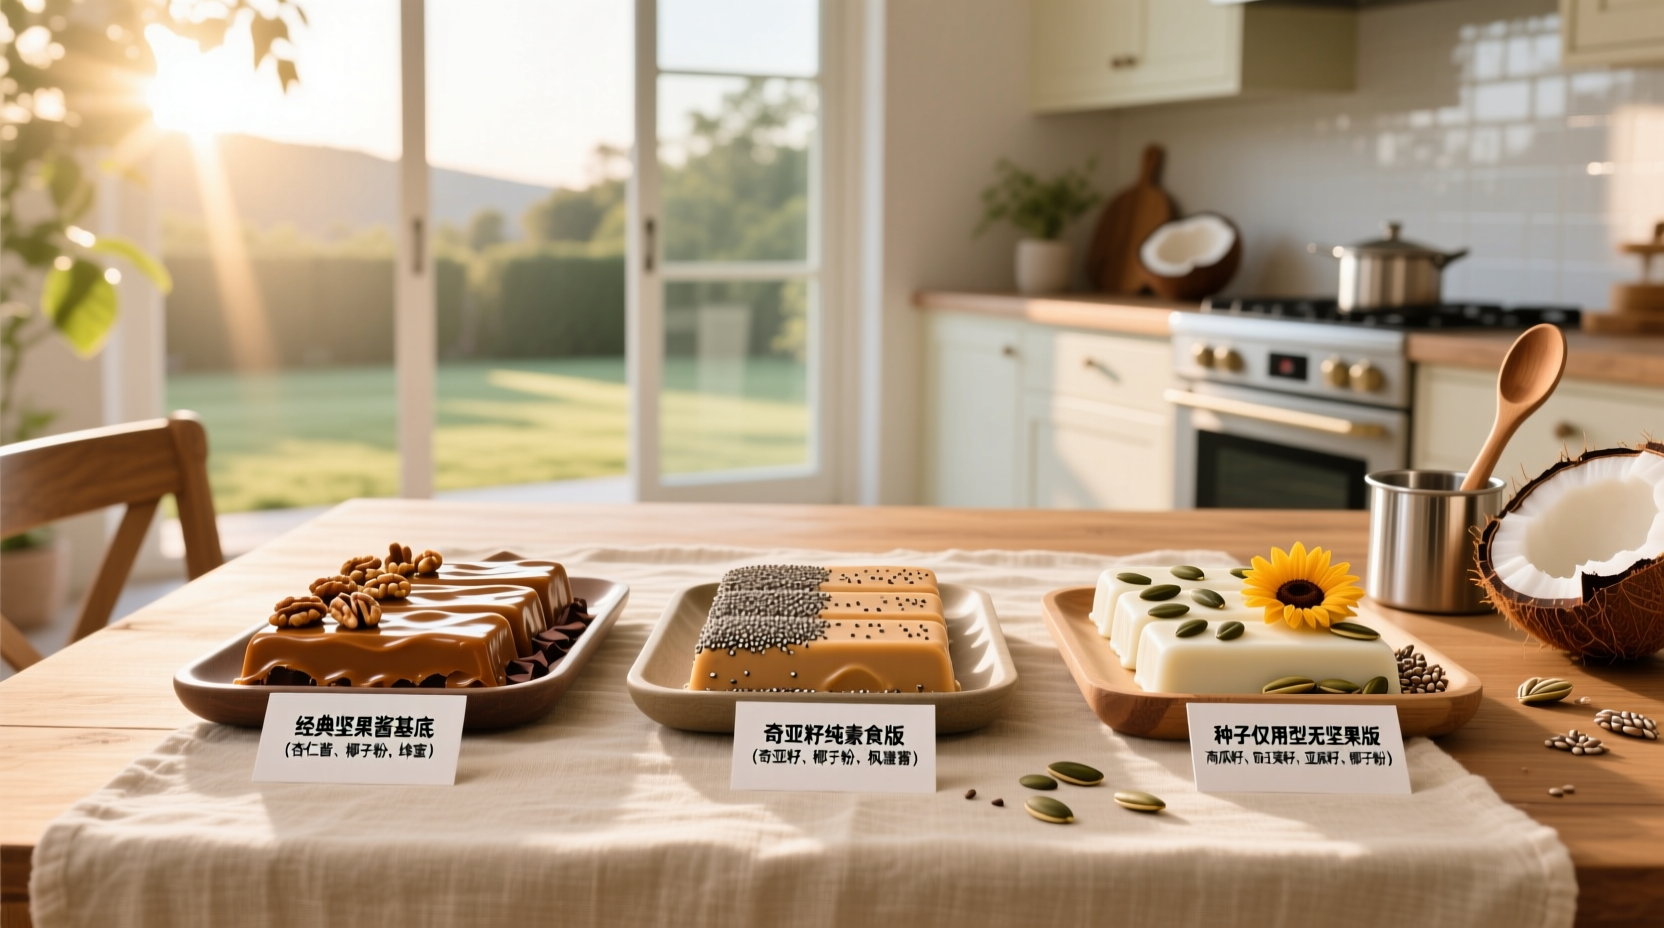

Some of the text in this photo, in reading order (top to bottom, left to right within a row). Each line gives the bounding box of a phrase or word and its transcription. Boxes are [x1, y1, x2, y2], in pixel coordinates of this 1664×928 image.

[294, 714, 435, 738] 经典坚果酱基底
[763, 723, 905, 746] 奇亚籽纯素食版
[1213, 724, 1381, 746] 种子仅用型无坚果版
